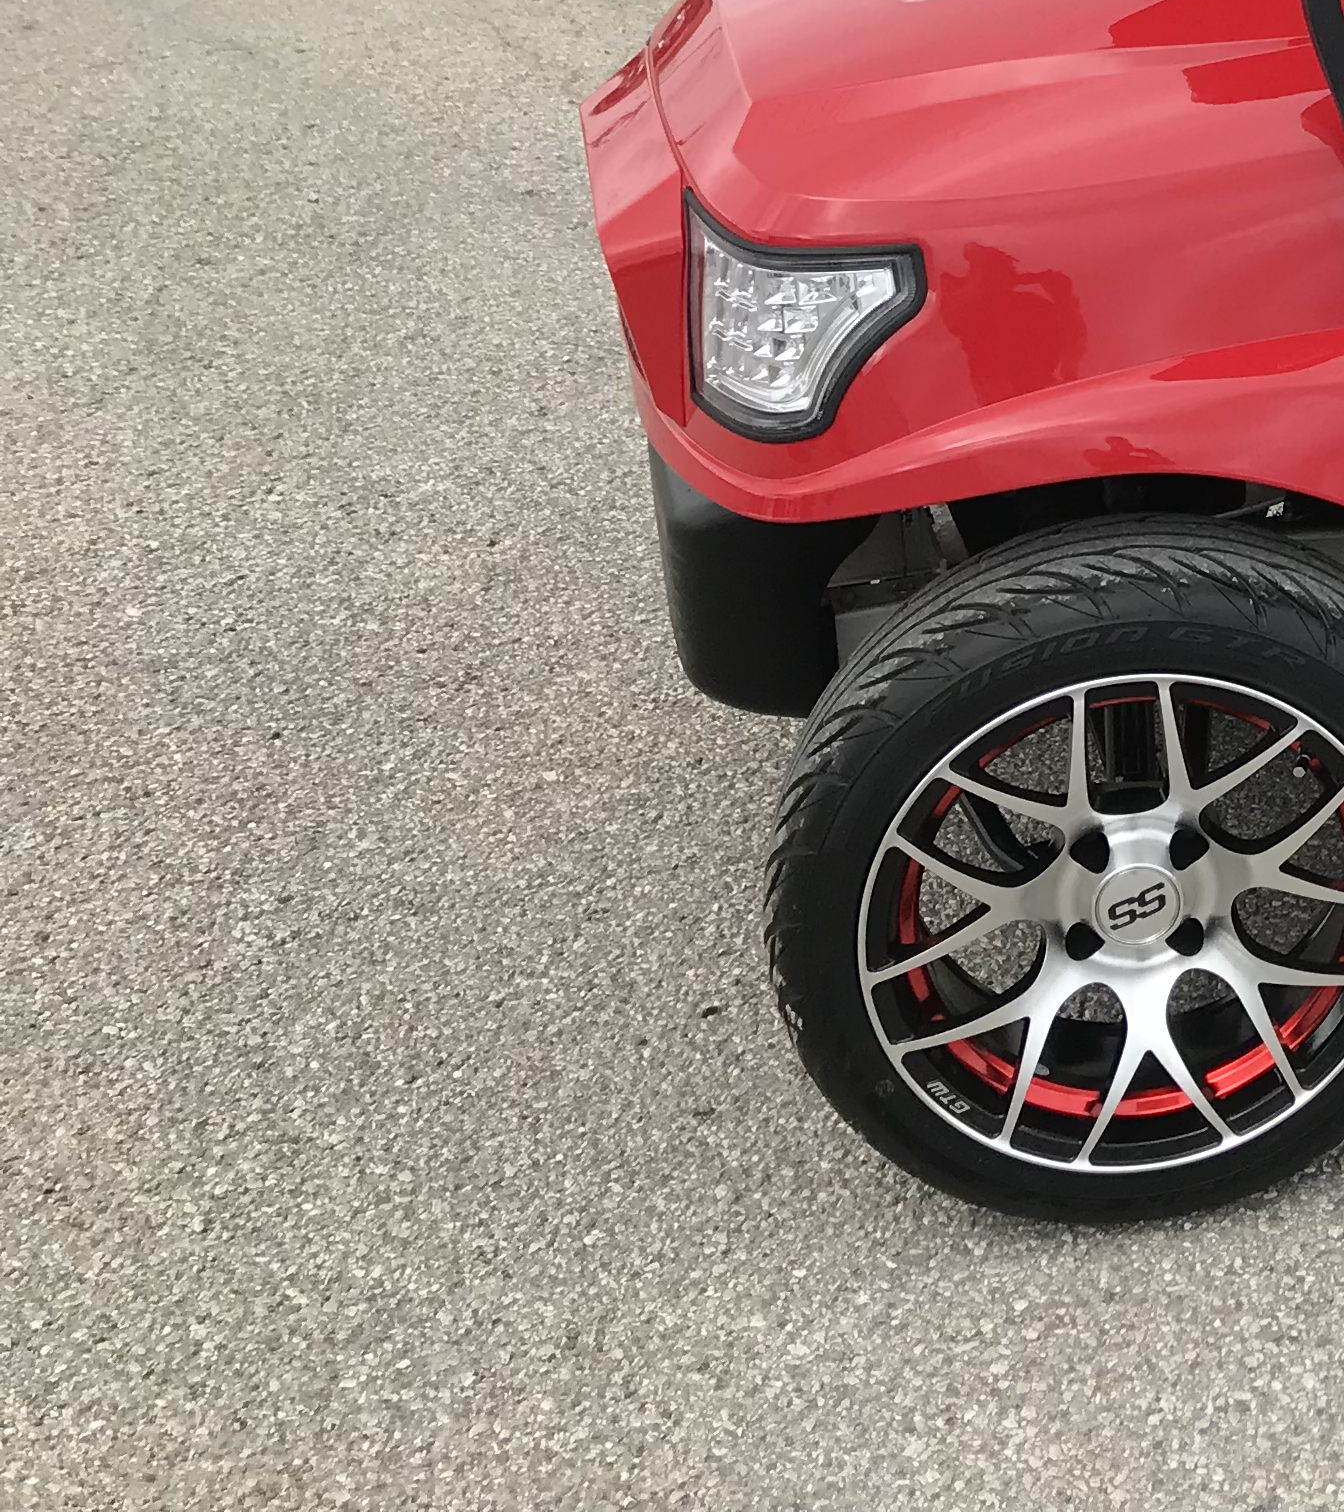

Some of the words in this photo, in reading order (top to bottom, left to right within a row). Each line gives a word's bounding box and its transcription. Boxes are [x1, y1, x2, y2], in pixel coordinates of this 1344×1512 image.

[1168, 625, 1306, 671] GTR
[1107, 881, 1166, 931] SS
[926, 1080, 971, 1114] GTW
